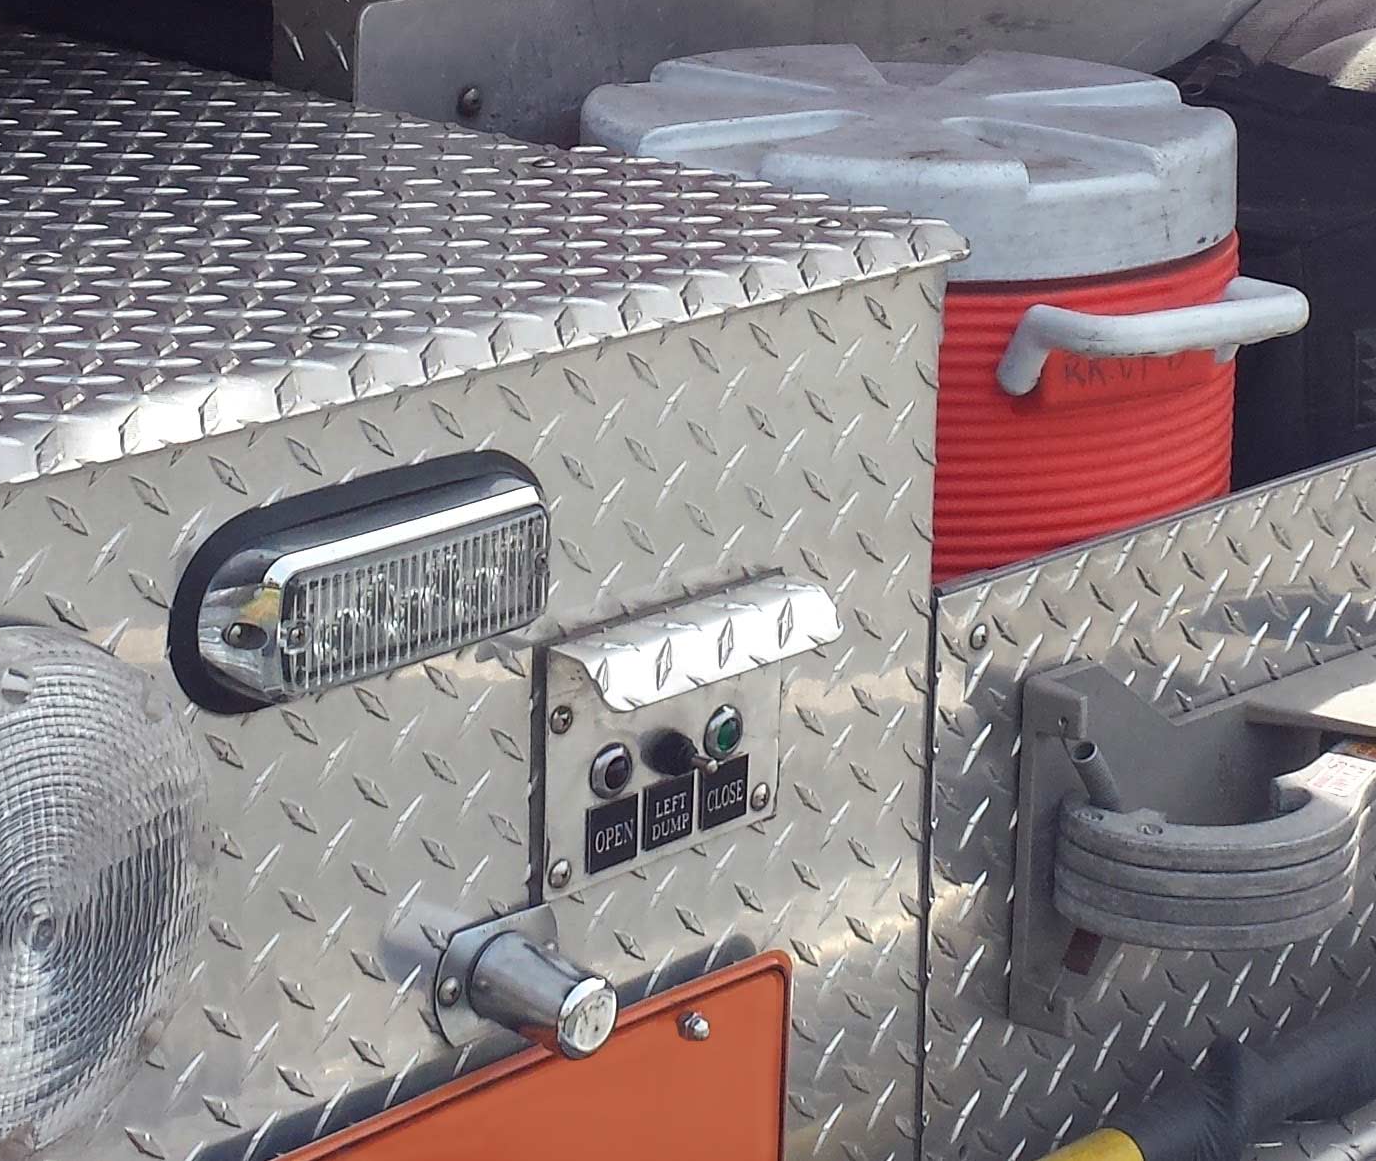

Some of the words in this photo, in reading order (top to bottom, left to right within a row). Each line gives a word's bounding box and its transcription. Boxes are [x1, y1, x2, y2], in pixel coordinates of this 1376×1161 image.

[655, 792, 687, 818] LEFT
[707, 779, 744, 812] CLOSE
[595, 819, 634, 853] OPEN
[652, 812, 690, 841] DUMP
